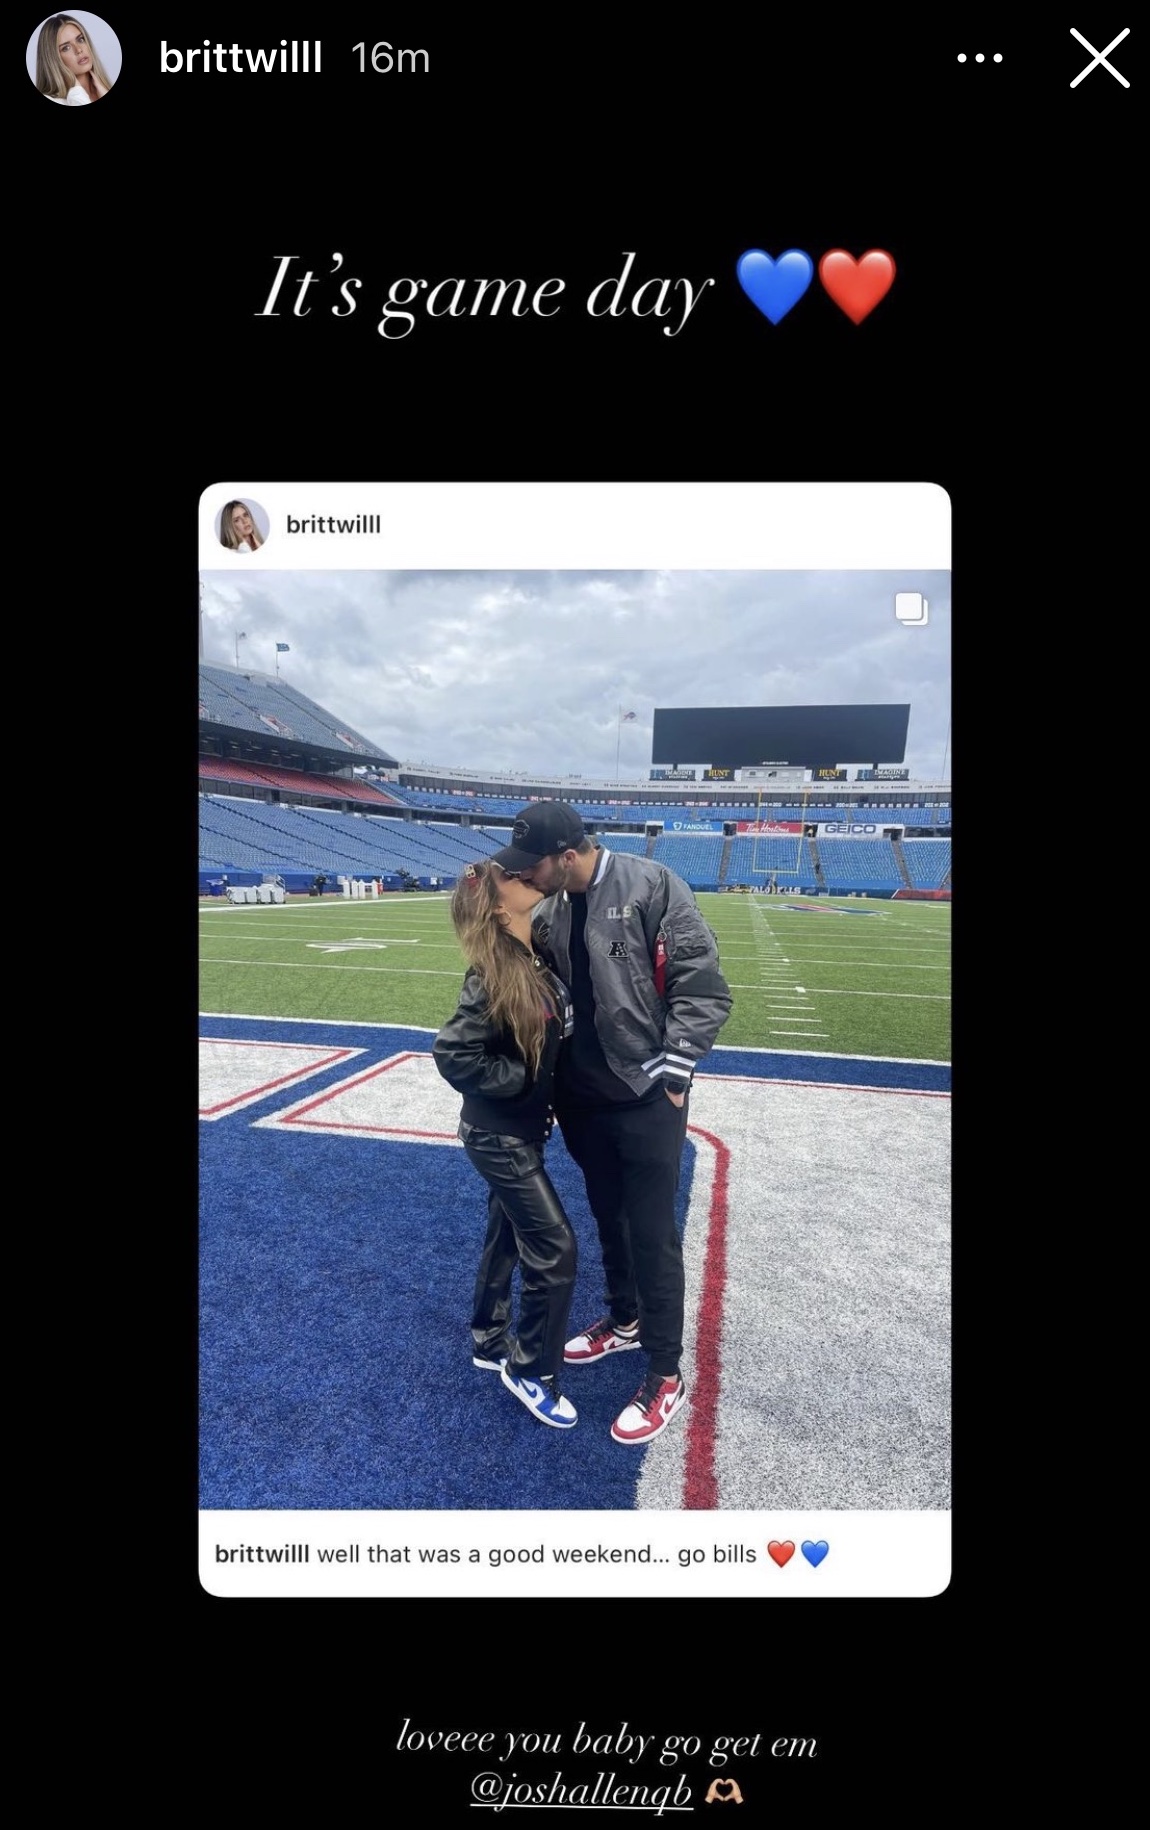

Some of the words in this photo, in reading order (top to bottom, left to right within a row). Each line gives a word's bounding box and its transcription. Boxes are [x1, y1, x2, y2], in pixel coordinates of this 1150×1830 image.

[708, 769, 730, 777] HUNT
[818, 769, 841, 777] HUNT
[825, 824, 877, 834] GEICO
